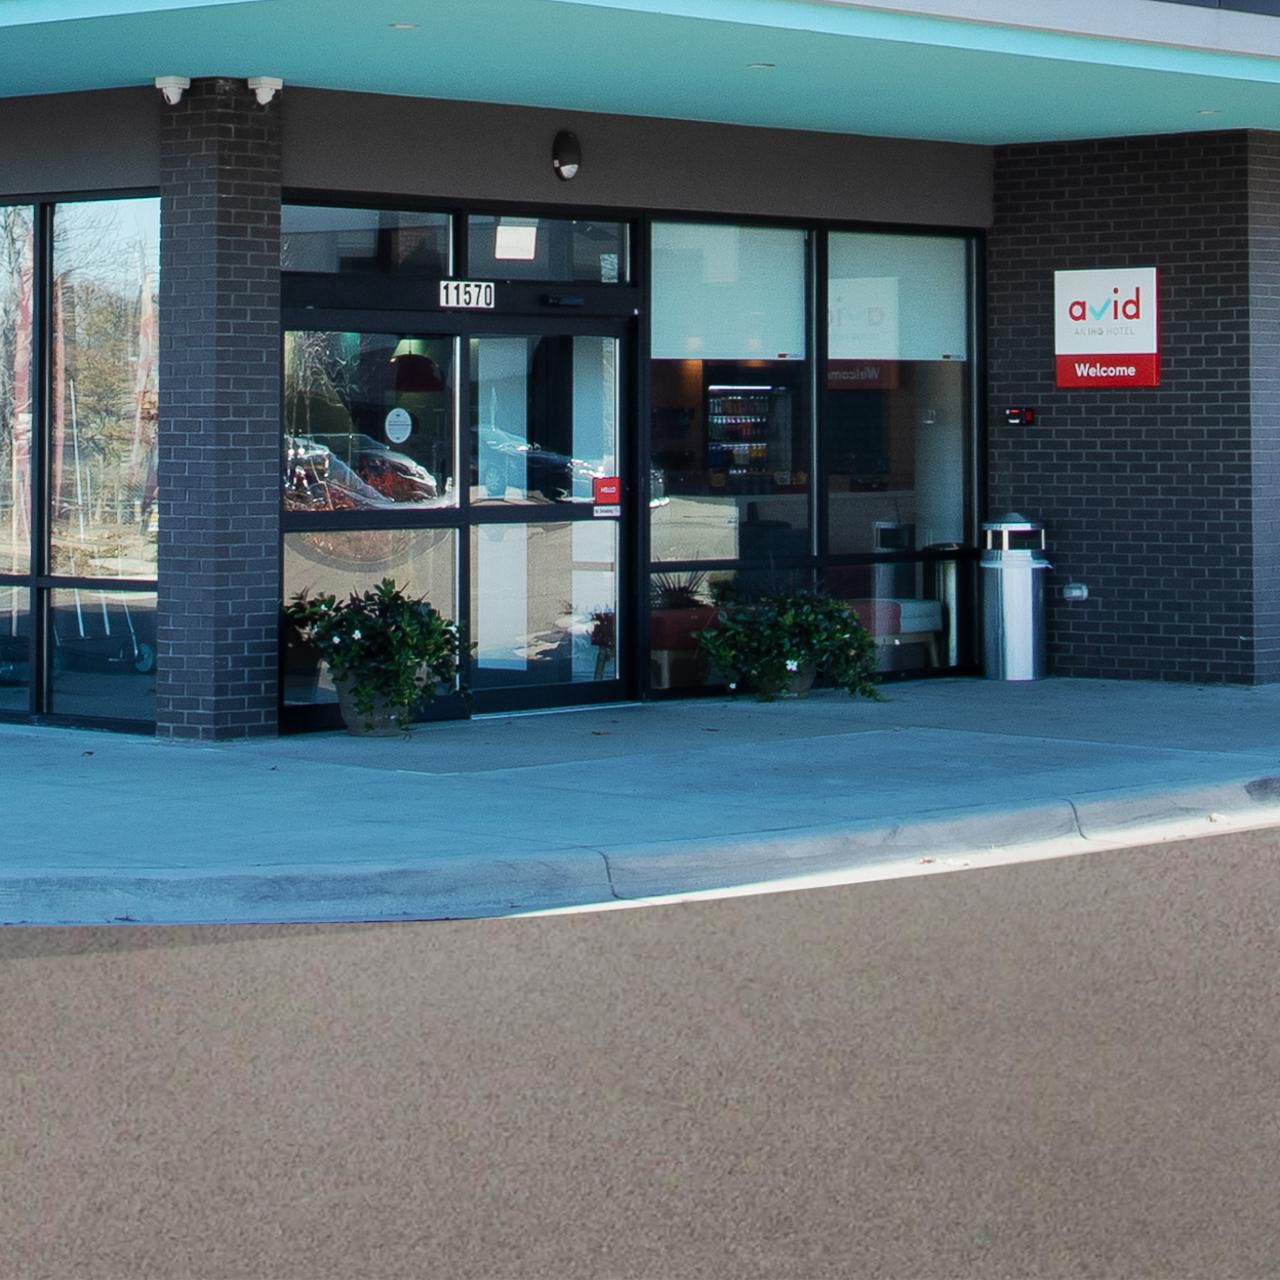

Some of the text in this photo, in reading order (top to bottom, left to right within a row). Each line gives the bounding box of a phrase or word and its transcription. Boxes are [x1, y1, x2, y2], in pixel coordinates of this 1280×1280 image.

[442, 282, 493, 307] 11570
[1068, 286, 1141, 322] avid
[1106, 326, 1136, 336] HOTEL
[1074, 362, 1137, 377] Welcome
